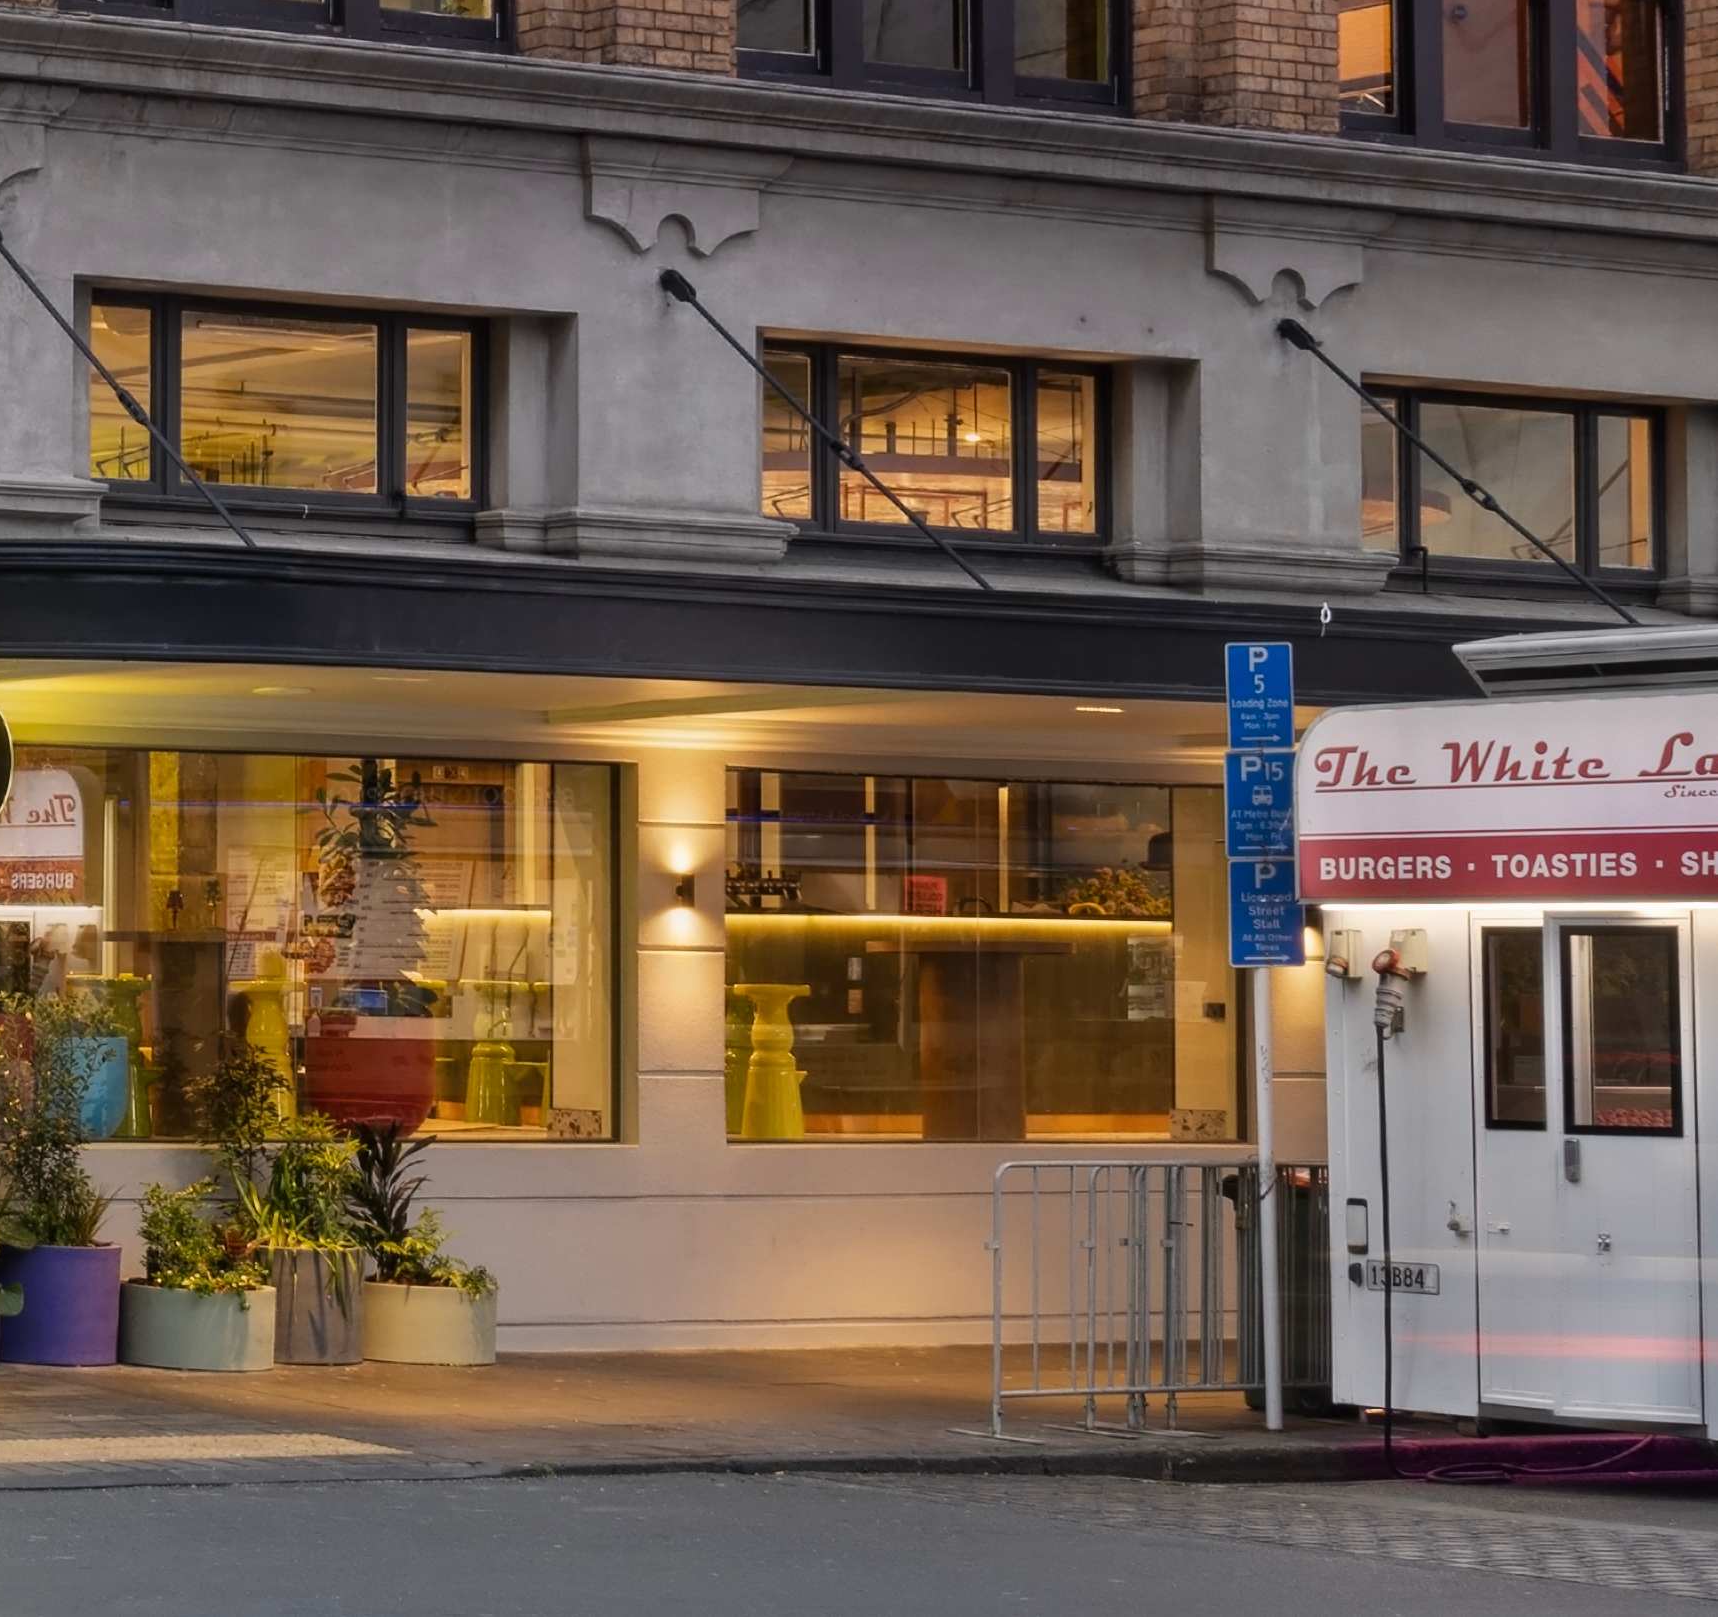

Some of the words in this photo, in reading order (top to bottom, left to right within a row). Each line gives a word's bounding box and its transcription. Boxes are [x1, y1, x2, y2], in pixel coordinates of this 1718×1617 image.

[1249, 647, 1268, 672] P
[1254, 674, 1265, 694] 5
[1231, 699, 1264, 710] Loading
[1267, 699, 1289, 708] Zone
[1241, 757, 1261, 781] P
[1265, 762, 1283, 781] 15
[1314, 745, 1417, 788] The
[1441, 740, 1612, 783] White
[1255, 863, 1276, 889] P
[1320, 855, 1452, 881] BURGERS
[1491, 852, 1637, 878] TOASTIES
